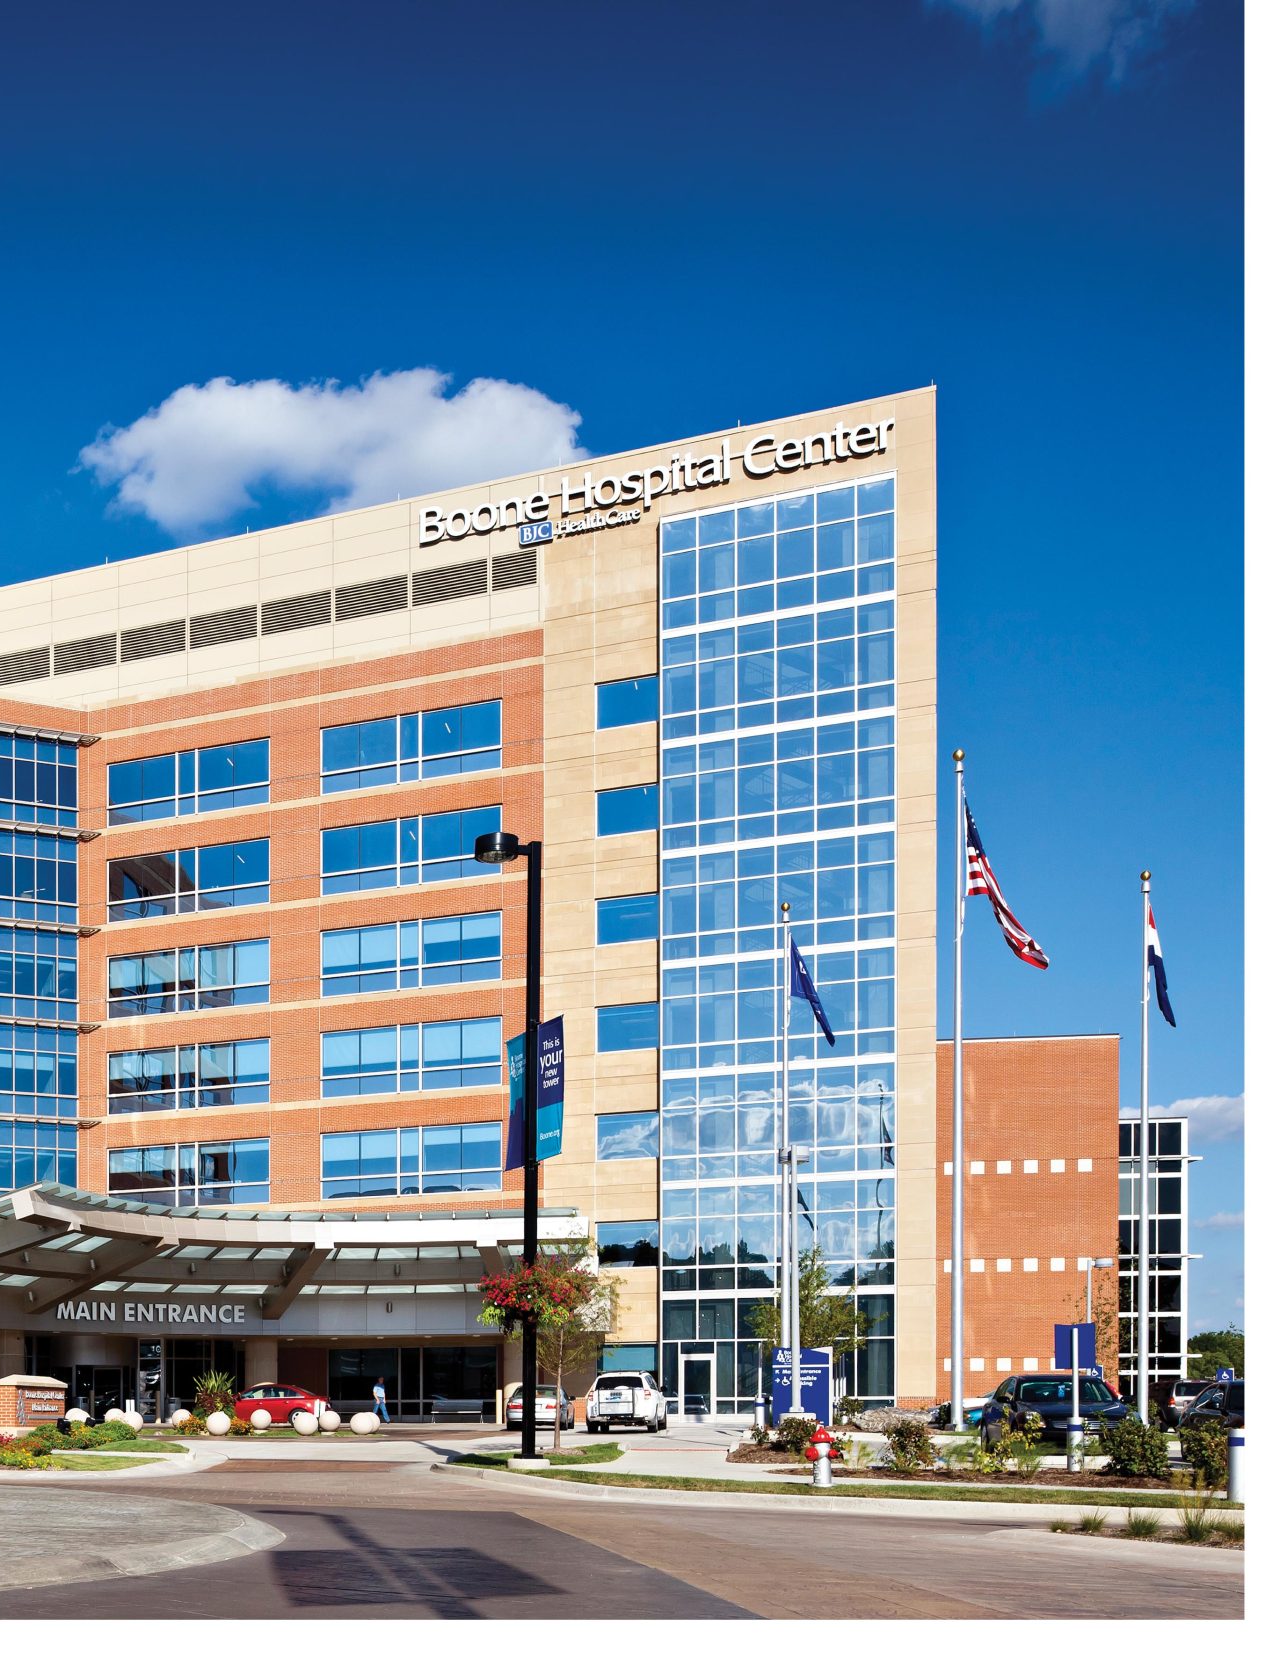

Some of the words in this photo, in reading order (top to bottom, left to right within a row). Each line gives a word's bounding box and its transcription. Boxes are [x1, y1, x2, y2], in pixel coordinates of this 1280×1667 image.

[419, 490, 550, 543] Boone
[561, 438, 730, 513] Hospital
[744, 417, 896, 475] Center
[523, 523, 550, 542] BJC
[554, 508, 641, 535] HealthCare
[543, 1039, 554, 1051] This
[554, 1036, 560, 1047] is
[540, 1049, 563, 1075] your
[544, 1067, 558, 1078] new
[543, 1076, 560, 1089] tower
[56, 1301, 116, 1321] MAIN
[123, 1302, 245, 1324] ENTRANCE
